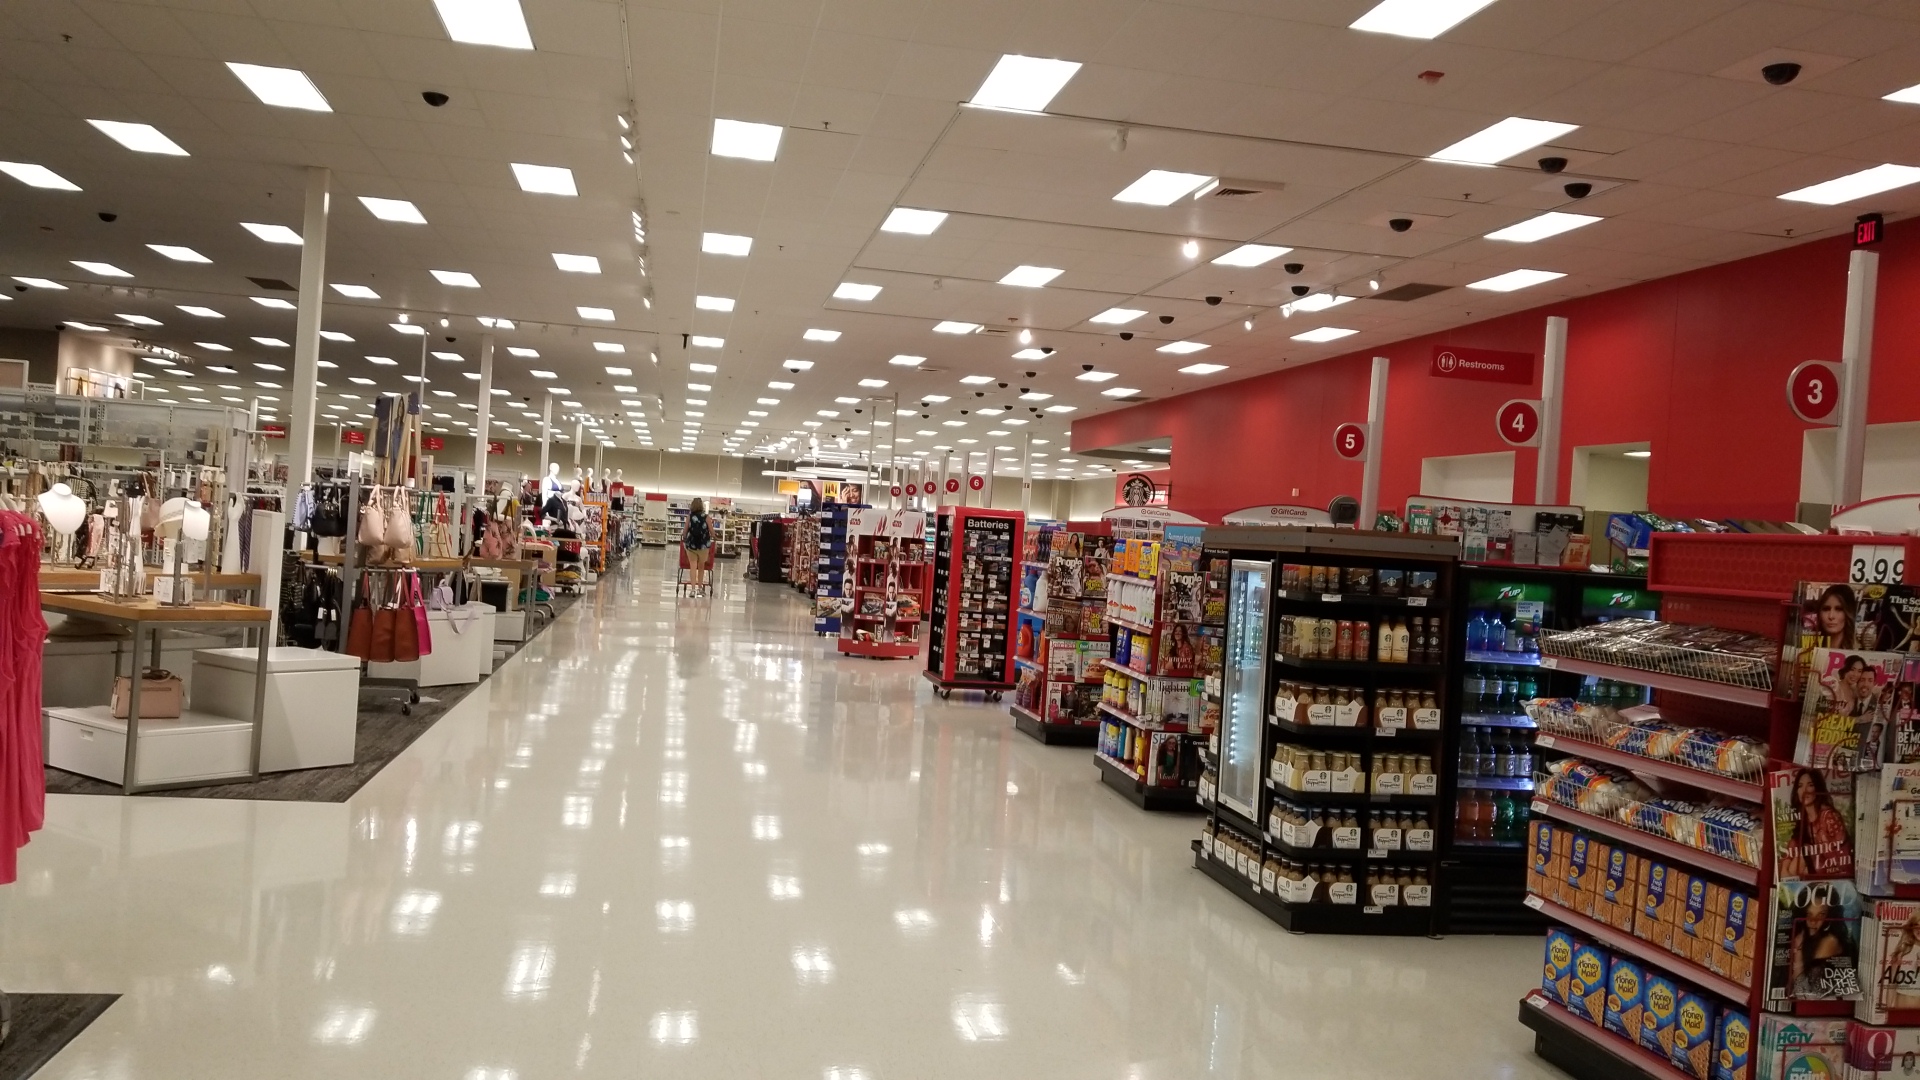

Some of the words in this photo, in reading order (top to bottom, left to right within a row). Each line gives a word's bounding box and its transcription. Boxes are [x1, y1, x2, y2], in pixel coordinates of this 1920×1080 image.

[1857, 220, 1876, 244] EXIT
[1459, 359, 1505, 371] Restrooms
[1807, 379, 1823, 404] 3
[1512, 413, 1524, 432] 4
[1345, 434, 1356, 449] 5
[1278, 508, 1308, 516] GiftCards
[968, 519, 1009, 529] Batteries
[1852, 558, 1904, 583] 3.99
[1817, 712, 1856, 731] DREAM
[1898, 732, 1908, 743] BE
[1779, 841, 1843, 858] Summer
[1651, 884, 1662, 892] Stacks
[1691, 894, 1702, 902] Fresh
[1779, 884, 1853, 908] VOGUE
[1689, 899, 1701, 908] Stacks
[1730, 915, 1742, 924] Stacks
[1732, 910, 1742, 918] Fresh
[1551, 944, 1569, 955] Honey
[1553, 954, 1566, 962] Maid
[1578, 960, 1599, 972] Honey
[1582, 969, 1597, 977] Maid
[1824, 968, 1856, 979] DAYS
[1878, 966, 1920, 984] Abs!
[1615, 975, 1637, 987] Honey
[1820, 978, 1833, 988] IN
[1834, 978, 1857, 988] THE
[1618, 984, 1633, 993] Maid
[1835, 986, 1859, 995] SUN
[1650, 991, 1671, 1005] Honey
[1653, 1002, 1669, 1010] Maid
[1682, 1009, 1703, 1022] Honey
[1684, 1019, 1700, 1029] Maid
[1727, 1028, 1748, 1040] Honey
[1777, 1033, 1814, 1043] HGTV
[1730, 1038, 1745, 1048] Maid
